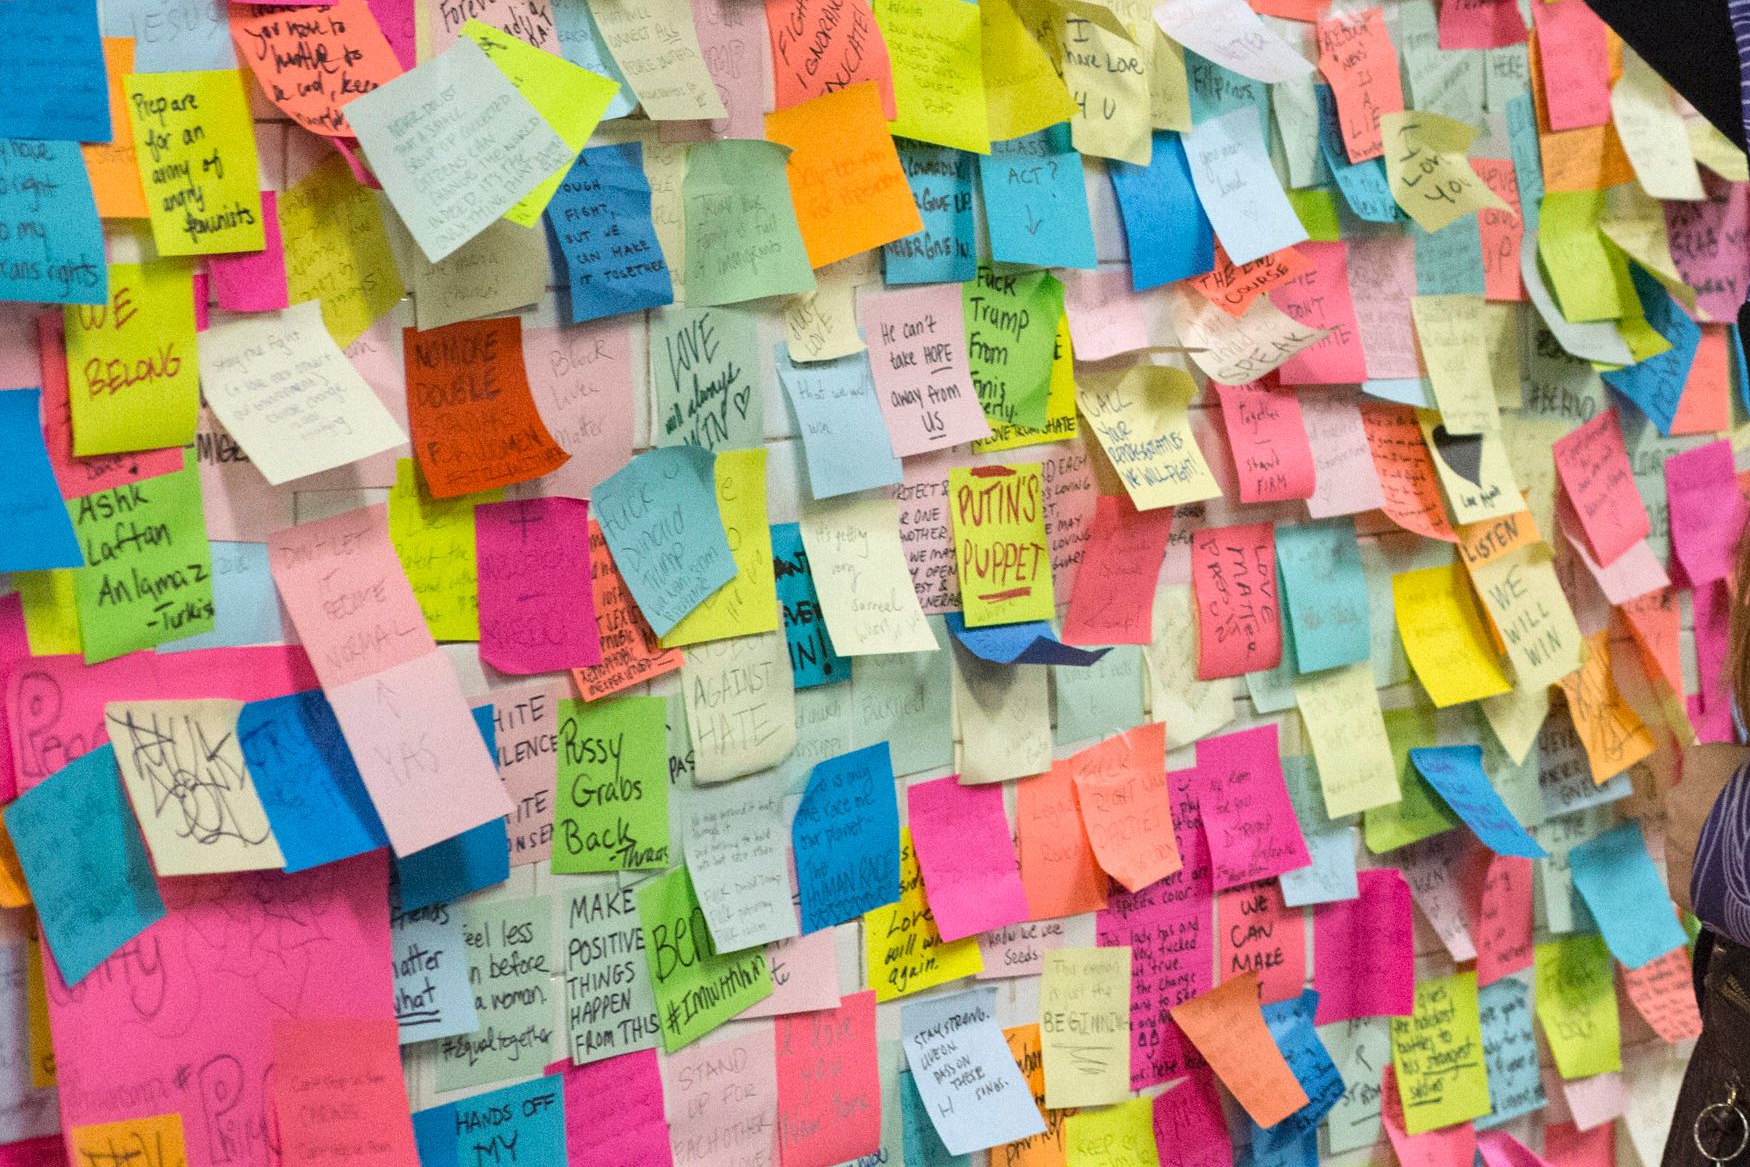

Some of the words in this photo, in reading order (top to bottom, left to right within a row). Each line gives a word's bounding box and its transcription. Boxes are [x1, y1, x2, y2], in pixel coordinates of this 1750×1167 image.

[1066, 17, 1090, 44] I
[1062, 47, 1102, 70] have
[131, 91, 200, 128] Prepare
[1102, 98, 1118, 120] U
[144, 133, 173, 161] for
[184, 125, 206, 144] an
[151, 160, 192, 188] army
[201, 149, 225, 179] of
[161, 186, 206, 214] angry
[613, 240, 651, 260] MAKE
[603, 259, 667, 281] TOGETHER
[976, 265, 1017, 298] Fuck
[78, 287, 138, 332] WE
[969, 296, 1031, 344] Trump
[880, 321, 897, 344] He
[902, 314, 938, 340] can't
[664, 312, 721, 393] LOVE
[889, 347, 918, 369] take
[924, 341, 954, 366] HOPE
[969, 331, 1009, 366] From
[83, 342, 182, 401] BELONG
[890, 388, 925, 411] away
[927, 384, 963, 404] from
[921, 411, 946, 433] US
[957, 472, 1040, 527] PUTIN'S
[1460, 519, 1520, 564] LISTEN
[963, 537, 1046, 586] PUPPET
[1489, 564, 1530, 613] WE
[1502, 603, 1551, 646] WILL
[1524, 634, 1564, 668] WIN
[693, 660, 774, 709] AGAINST
[559, 717, 624, 779] Pussy
[571, 773, 643, 808] Grabs
[561, 817, 638, 855] Back
[569, 889, 636, 929] MAKE
[502, 920, 534, 946] less
[568, 928, 645, 971] POSITIVE
[1230, 921, 1274, 949] CAN
[489, 949, 551, 978] before
[887, 957, 941, 992] again.
[1231, 948, 1285, 974] MAKE
[567, 962, 636, 999] THINGS
[475, 995, 487, 1011] a
[569, 990, 632, 1030] HAPPEN
[575, 1025, 616, 1057] FROM
[617, 1013, 660, 1046] THIS
[455, 1104, 514, 1130] HANDS
[522, 1092, 557, 1119] OFF
[473, 1131, 519, 1165] MY
